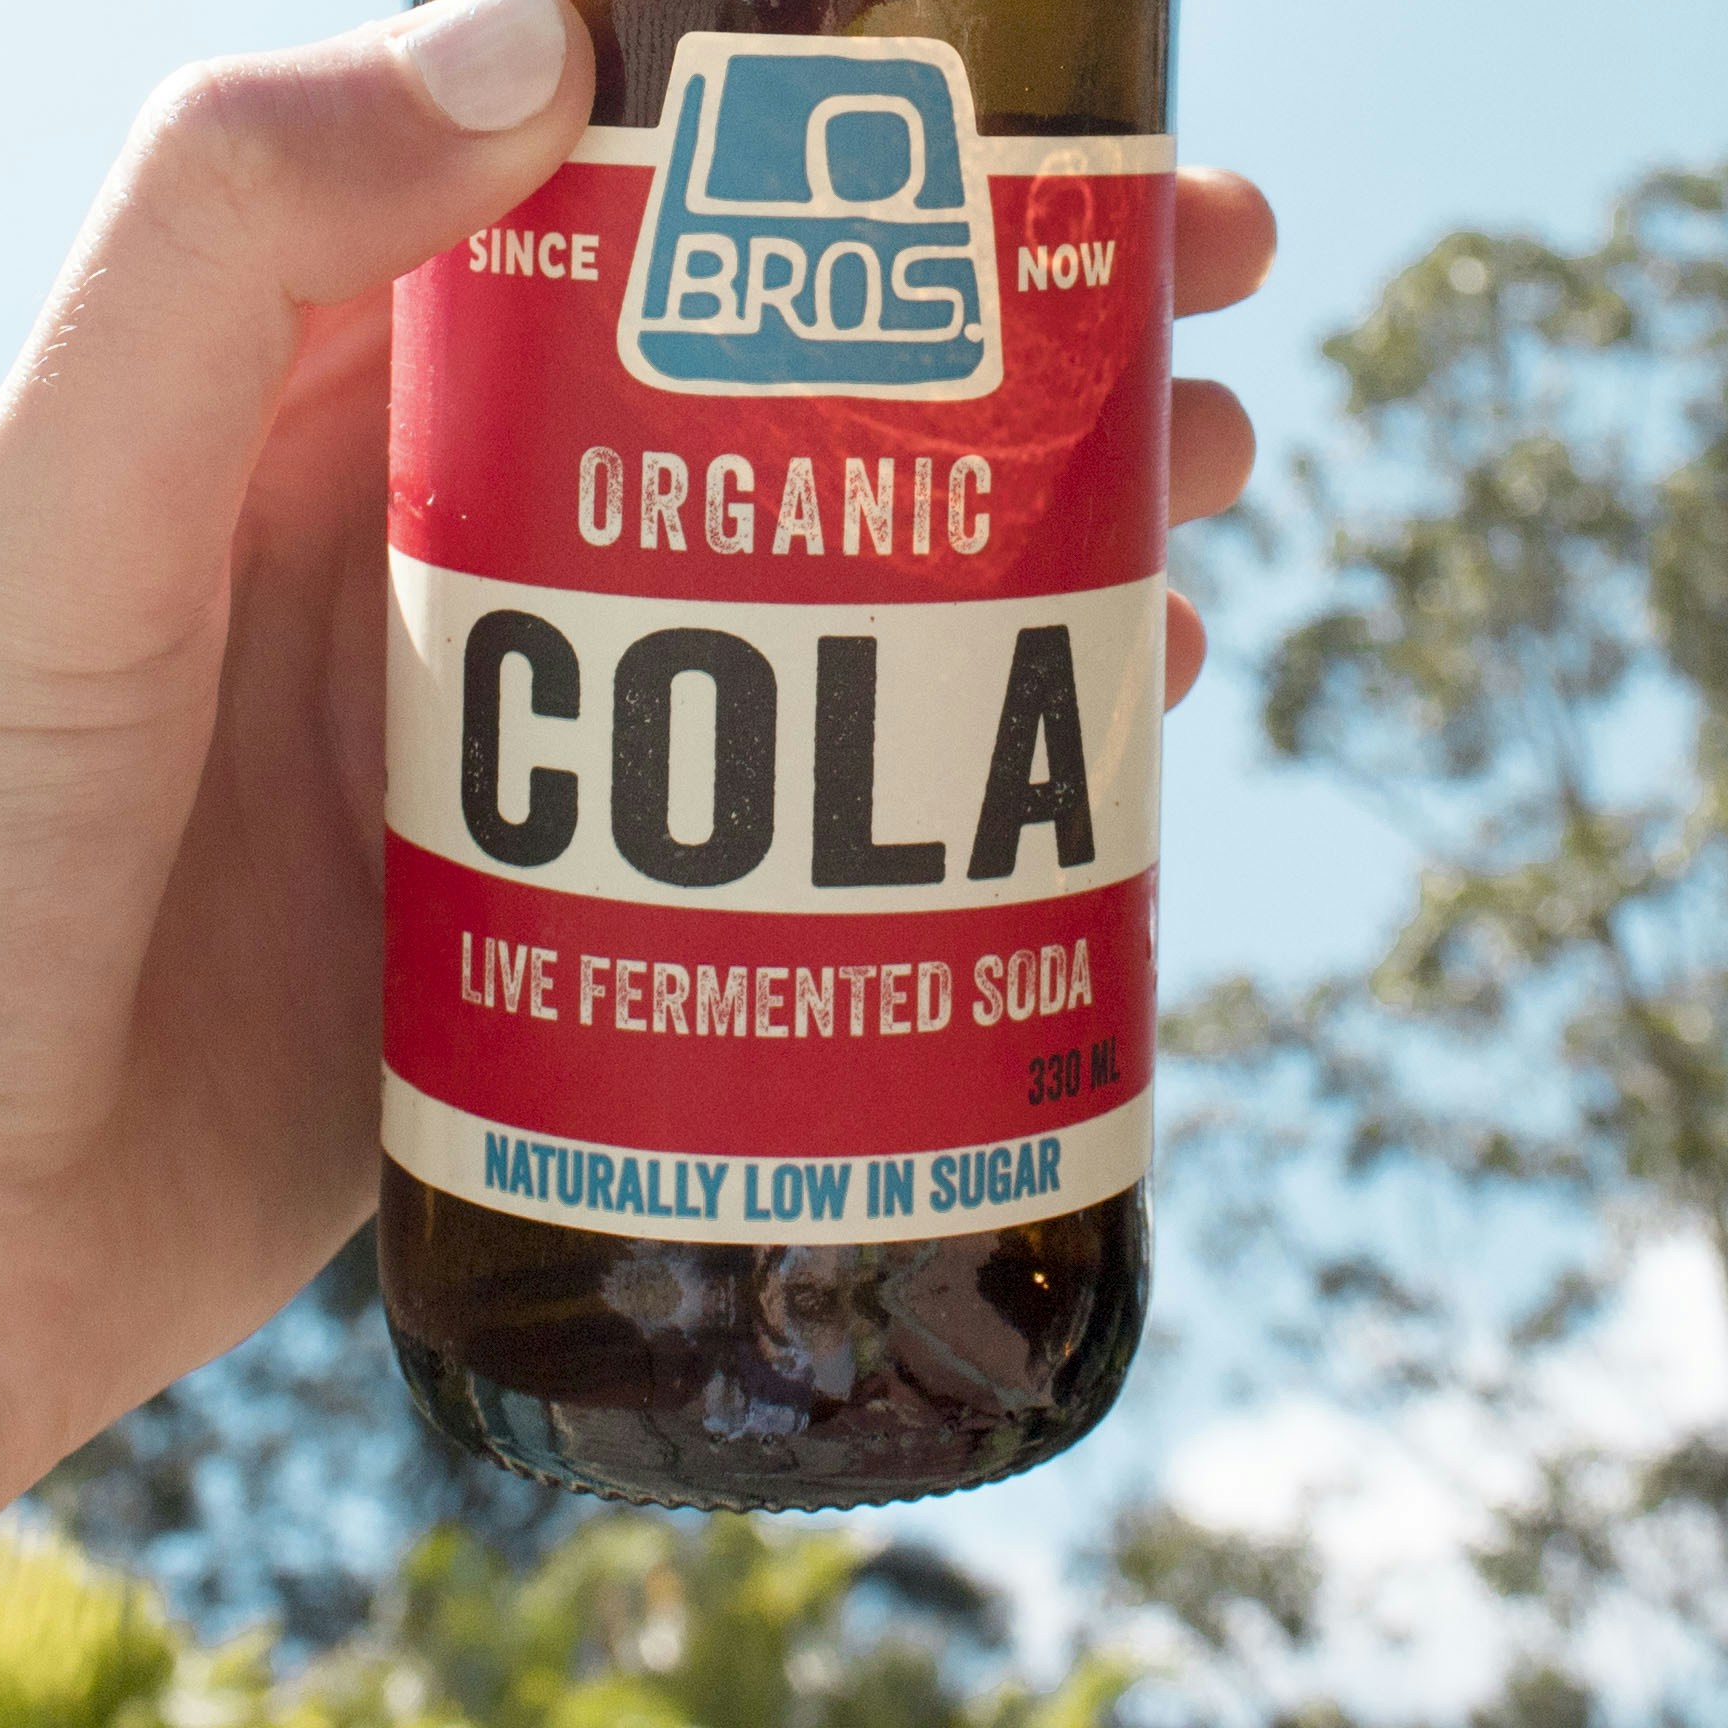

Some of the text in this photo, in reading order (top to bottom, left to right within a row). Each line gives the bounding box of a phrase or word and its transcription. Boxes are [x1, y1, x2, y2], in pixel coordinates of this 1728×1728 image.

[685, 55, 969, 223] LO
[469, 228, 600, 282] SINCE
[1017, 239, 1116, 293] NOW
[577, 445, 993, 557] ORGANIC
[461, 608, 1097, 889] COLA
[461, 930, 1094, 1039] LIVE FERMENTED SODA
[1028, 1034, 1121, 1106] 330 ML
[483, 1131, 1062, 1223] NATURALLY LOW IN SUGAR
